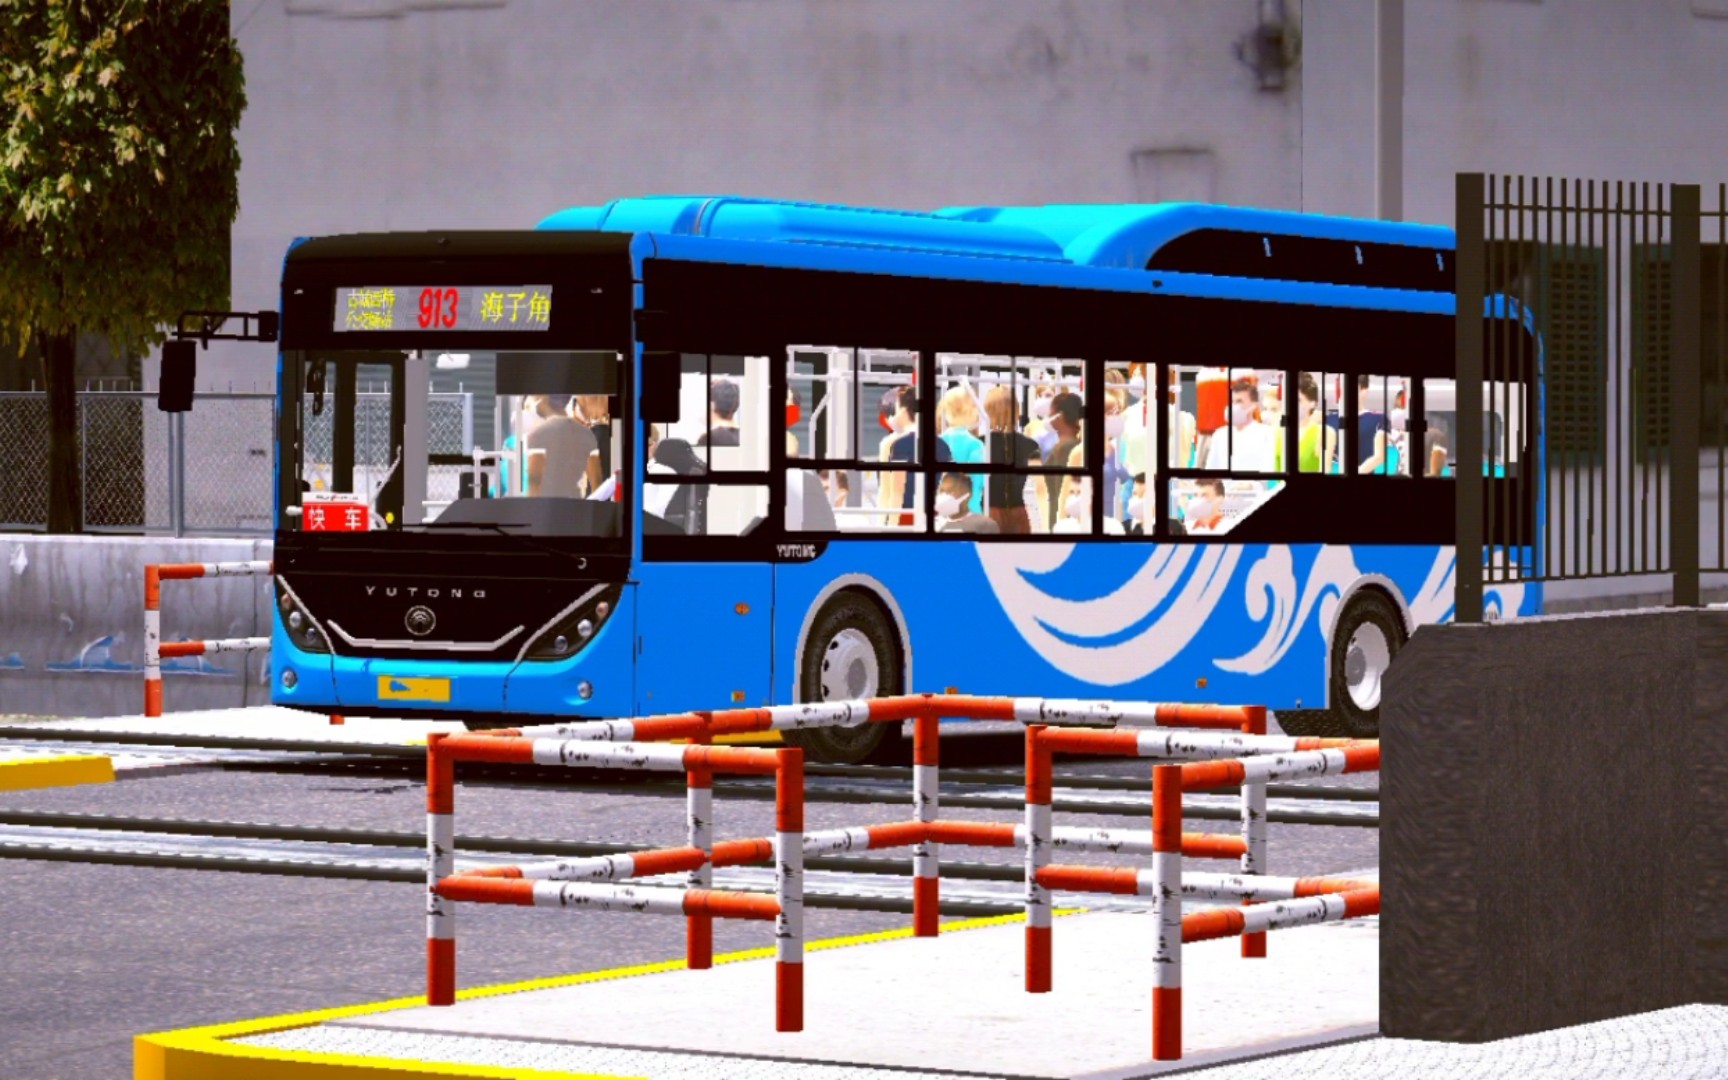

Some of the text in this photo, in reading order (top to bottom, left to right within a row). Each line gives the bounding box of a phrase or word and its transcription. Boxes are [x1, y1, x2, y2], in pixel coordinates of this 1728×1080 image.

[418, 287, 459, 329] 913
[480, 290, 550, 323] 海子角
[308, 505, 362, 531] 快车
[365, 585, 486, 598] YUTONG
